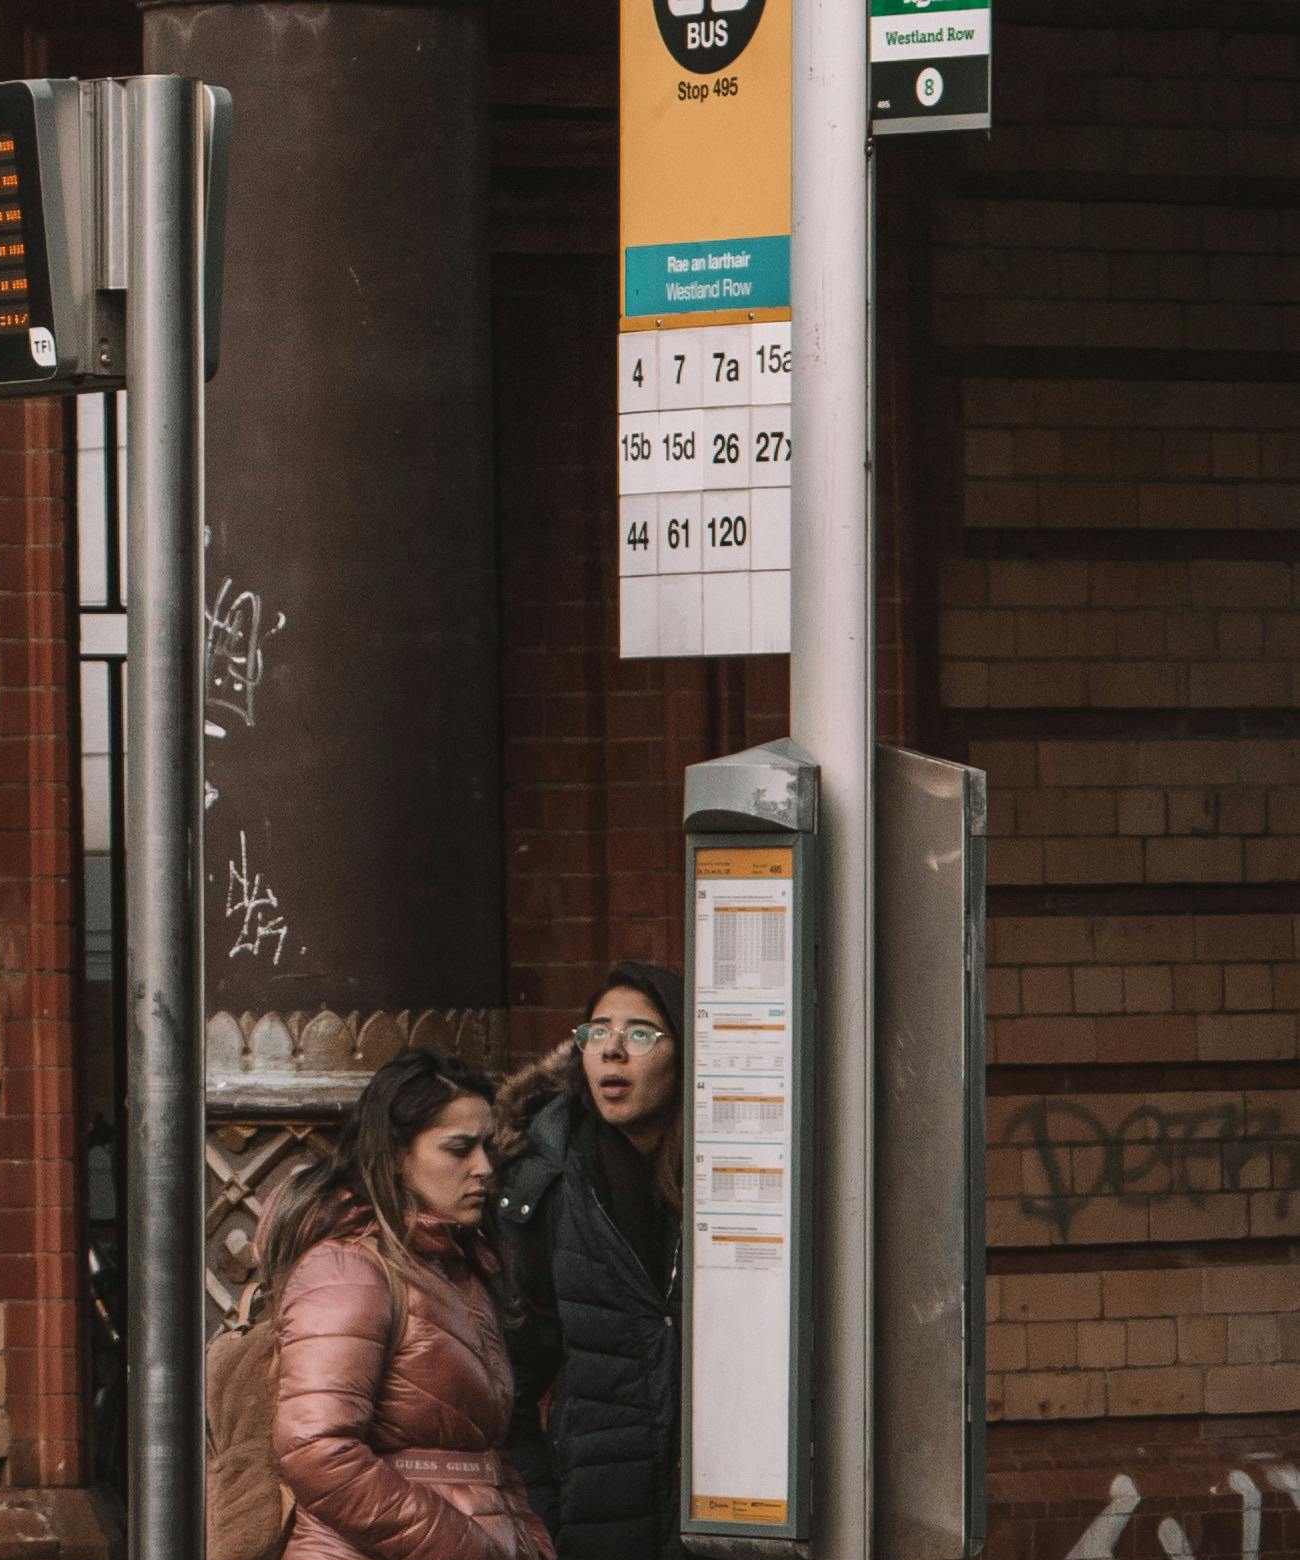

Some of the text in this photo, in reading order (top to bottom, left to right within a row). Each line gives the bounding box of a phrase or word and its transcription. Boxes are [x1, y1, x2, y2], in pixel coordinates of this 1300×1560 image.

[686, 18, 729, 50] BUS
[885, 27, 975, 46] Westland Row
[677, 77, 739, 103] Stop 495
[924, 78, 935, 96] 8
[667, 251, 751, 273] Rae an Iarthair
[665, 278, 752, 301] Westland Row
[34, 340, 51, 353] TFI
[632, 344, 792, 388] 4 7 7a 15a
[621, 431, 652, 461] 15b
[662, 431, 696, 461] 15d
[712, 432, 740, 464] 26
[627, 515, 747, 551] 44 61 120
[395, 1459, 438, 1470] GUESS
